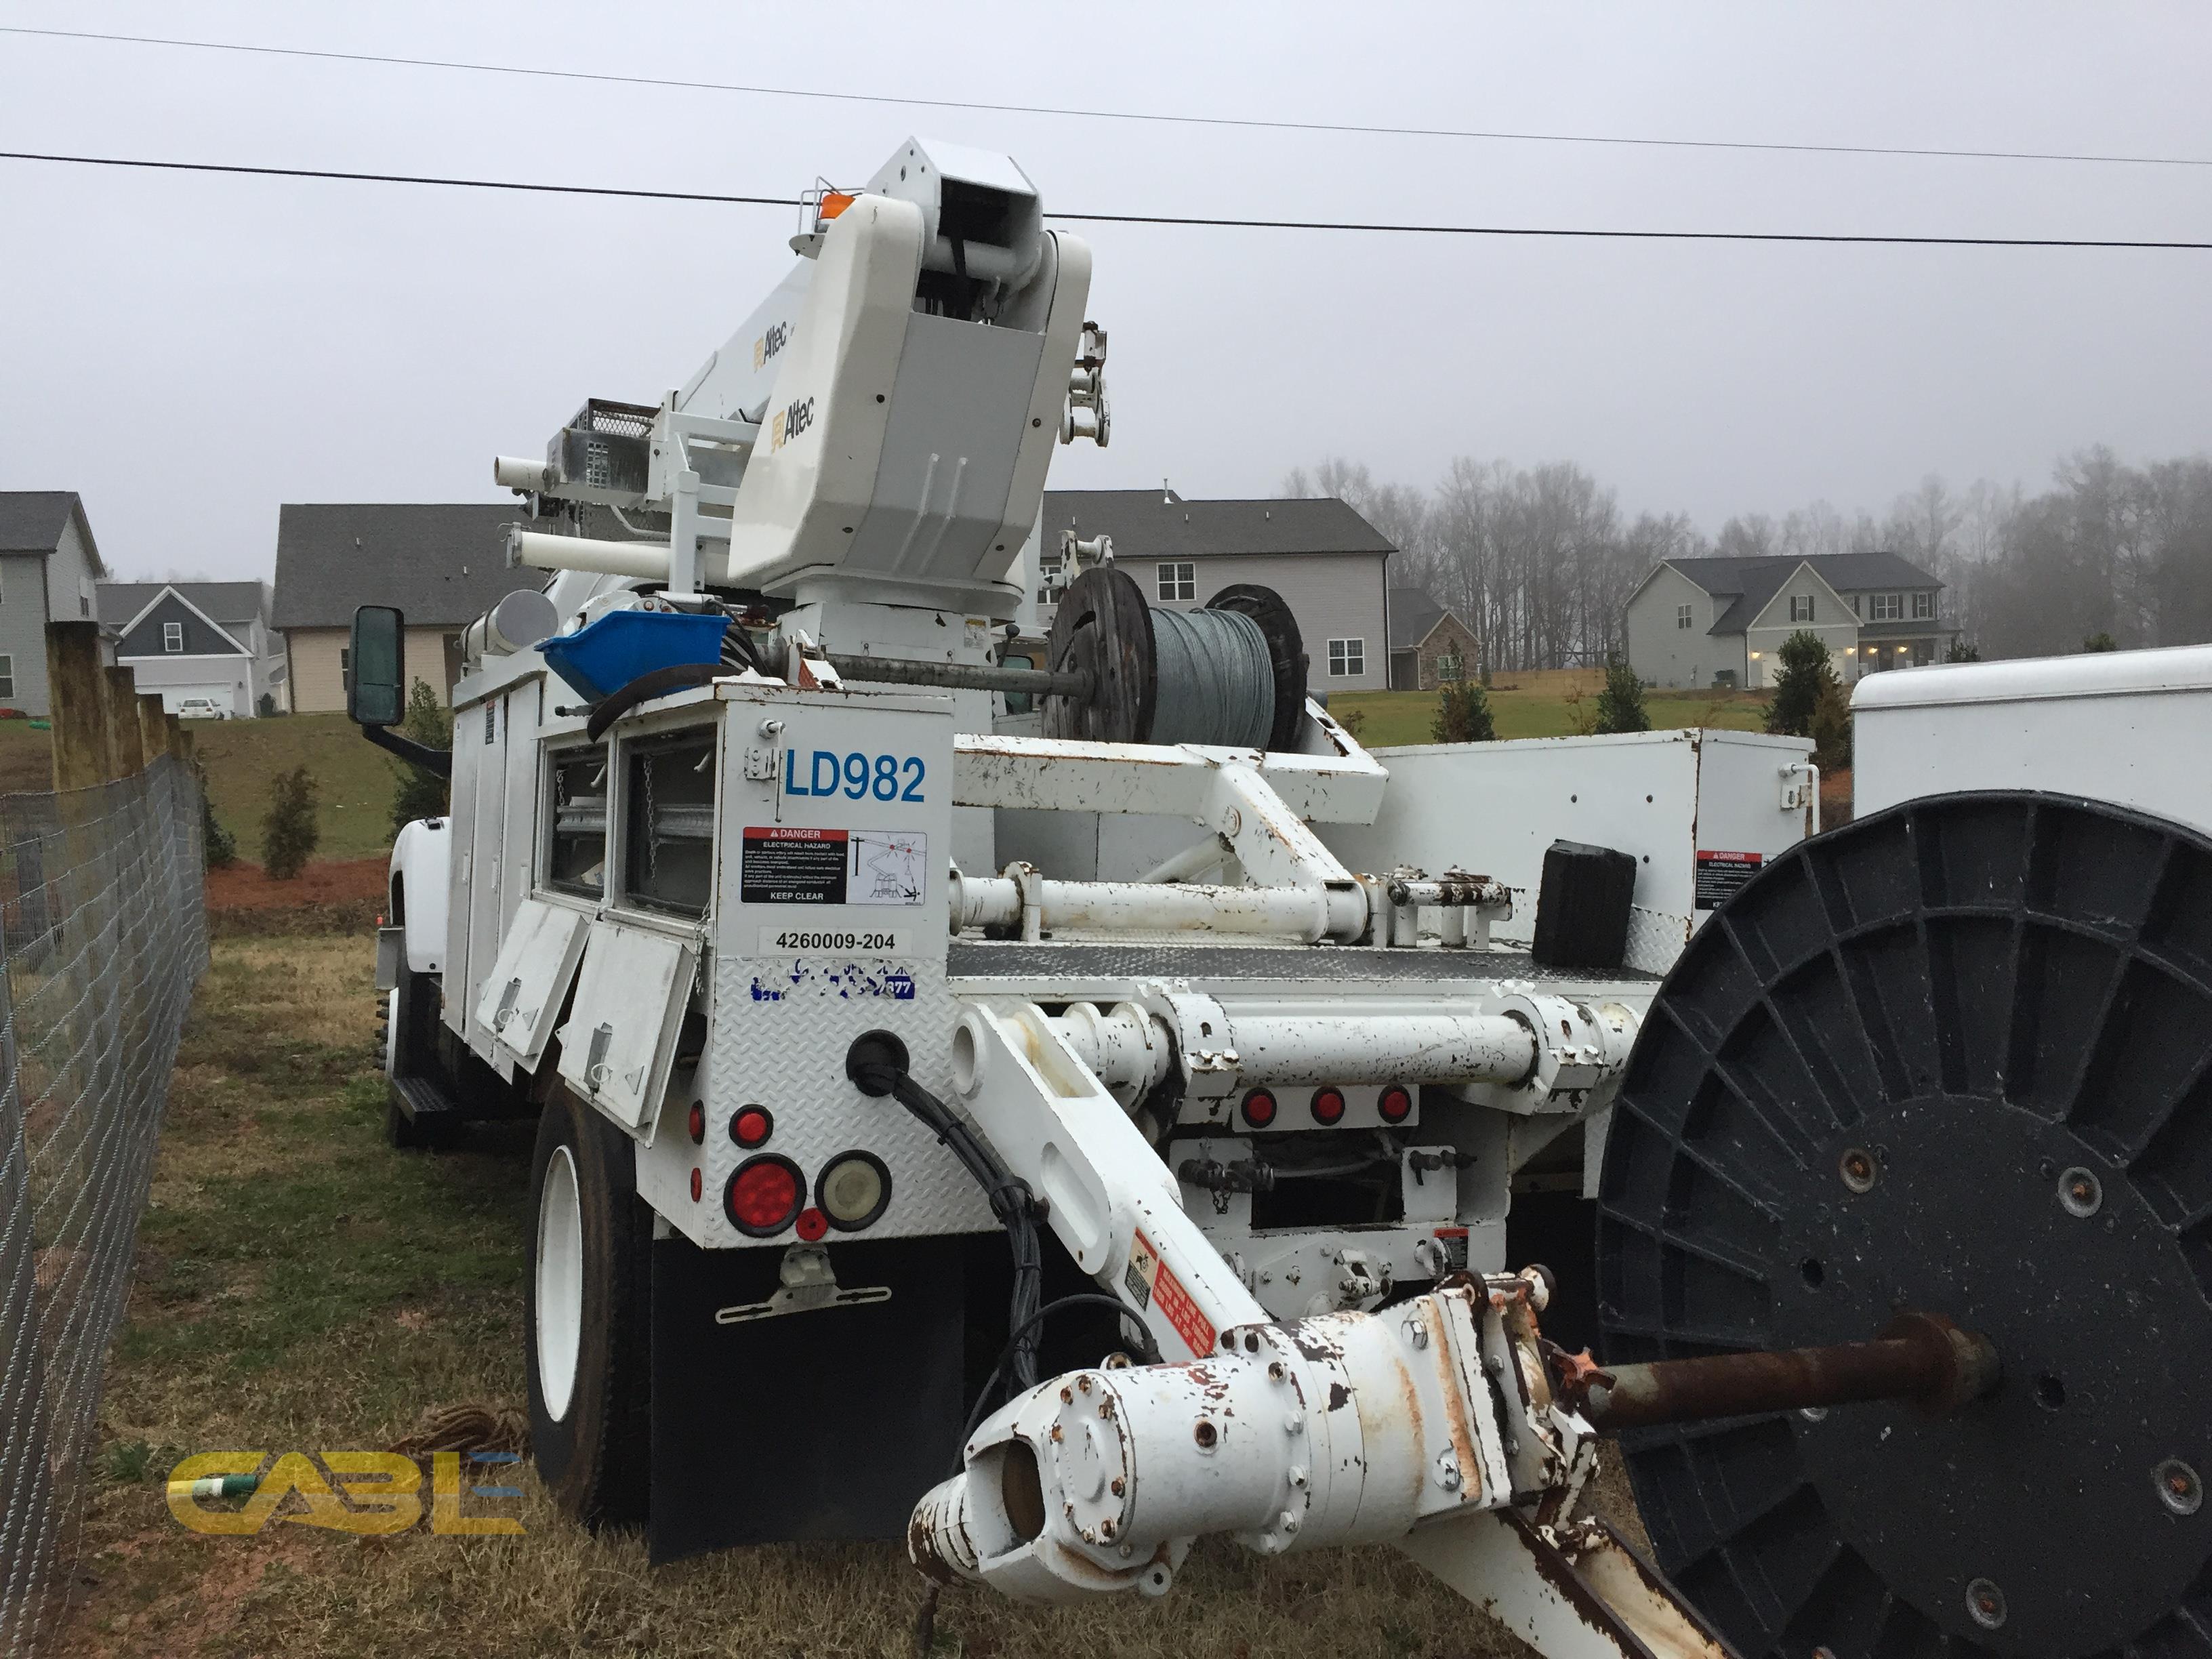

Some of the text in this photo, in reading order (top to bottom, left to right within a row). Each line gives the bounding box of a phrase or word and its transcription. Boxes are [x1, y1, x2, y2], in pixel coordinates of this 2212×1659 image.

[763, 321, 787, 365] Altec
[783, 396, 815, 445] Altec
[785, 749, 925, 802] LD982
[780, 829, 821, 838] DANGER
[1720, 852, 1745, 860] DANGER
[771, 892, 824, 901] KEEP CLEAR
[776, 933, 895, 949] 4260009-204
